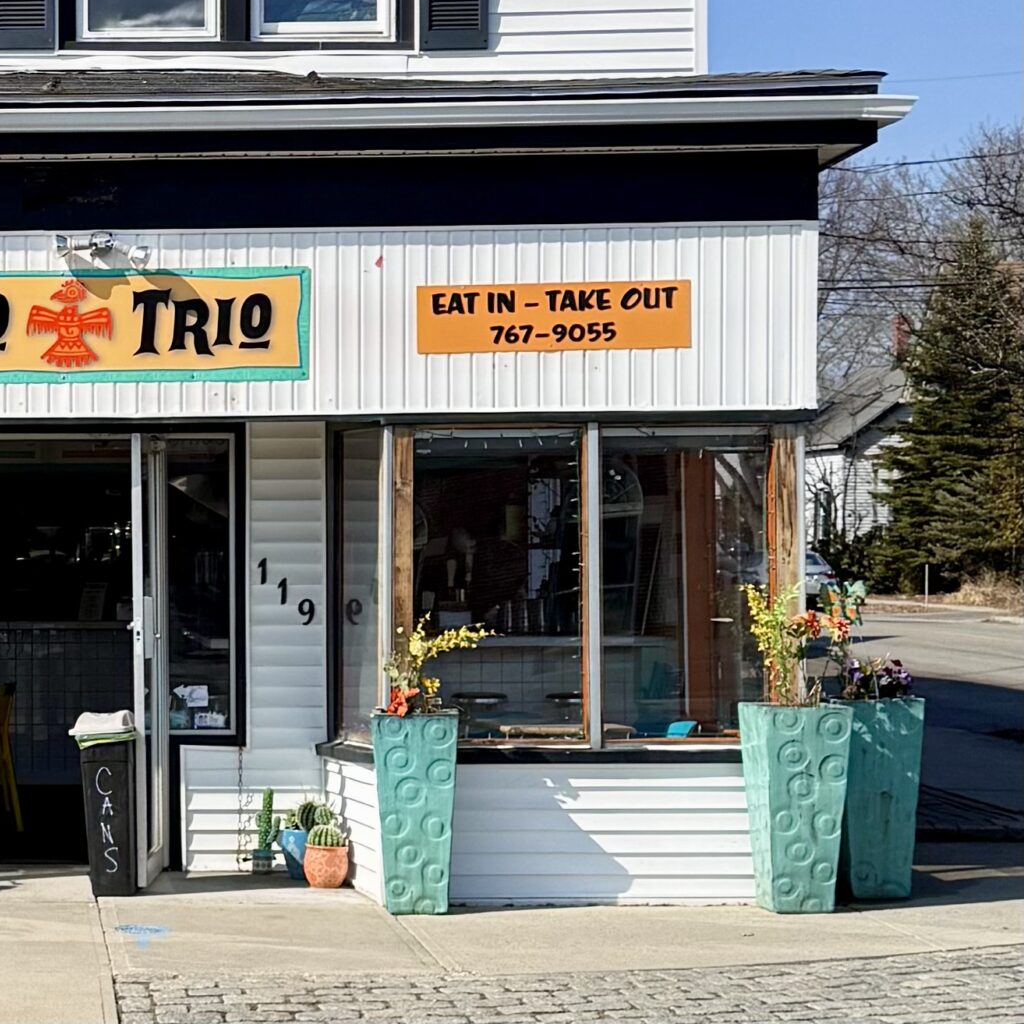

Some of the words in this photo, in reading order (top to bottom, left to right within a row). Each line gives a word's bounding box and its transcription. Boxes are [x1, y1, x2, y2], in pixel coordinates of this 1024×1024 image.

[132, 288, 272, 357] TRIO
[431, 292, 480, 315] EAT
[487, 290, 516, 314] IN
[545, 288, 612, 312] TAKE
[620, 286, 679, 310] OUT
[490, 321, 617, 345] 767-9055
[257, 557, 315, 626] 119
[96, 766, 119, 873] CANS
